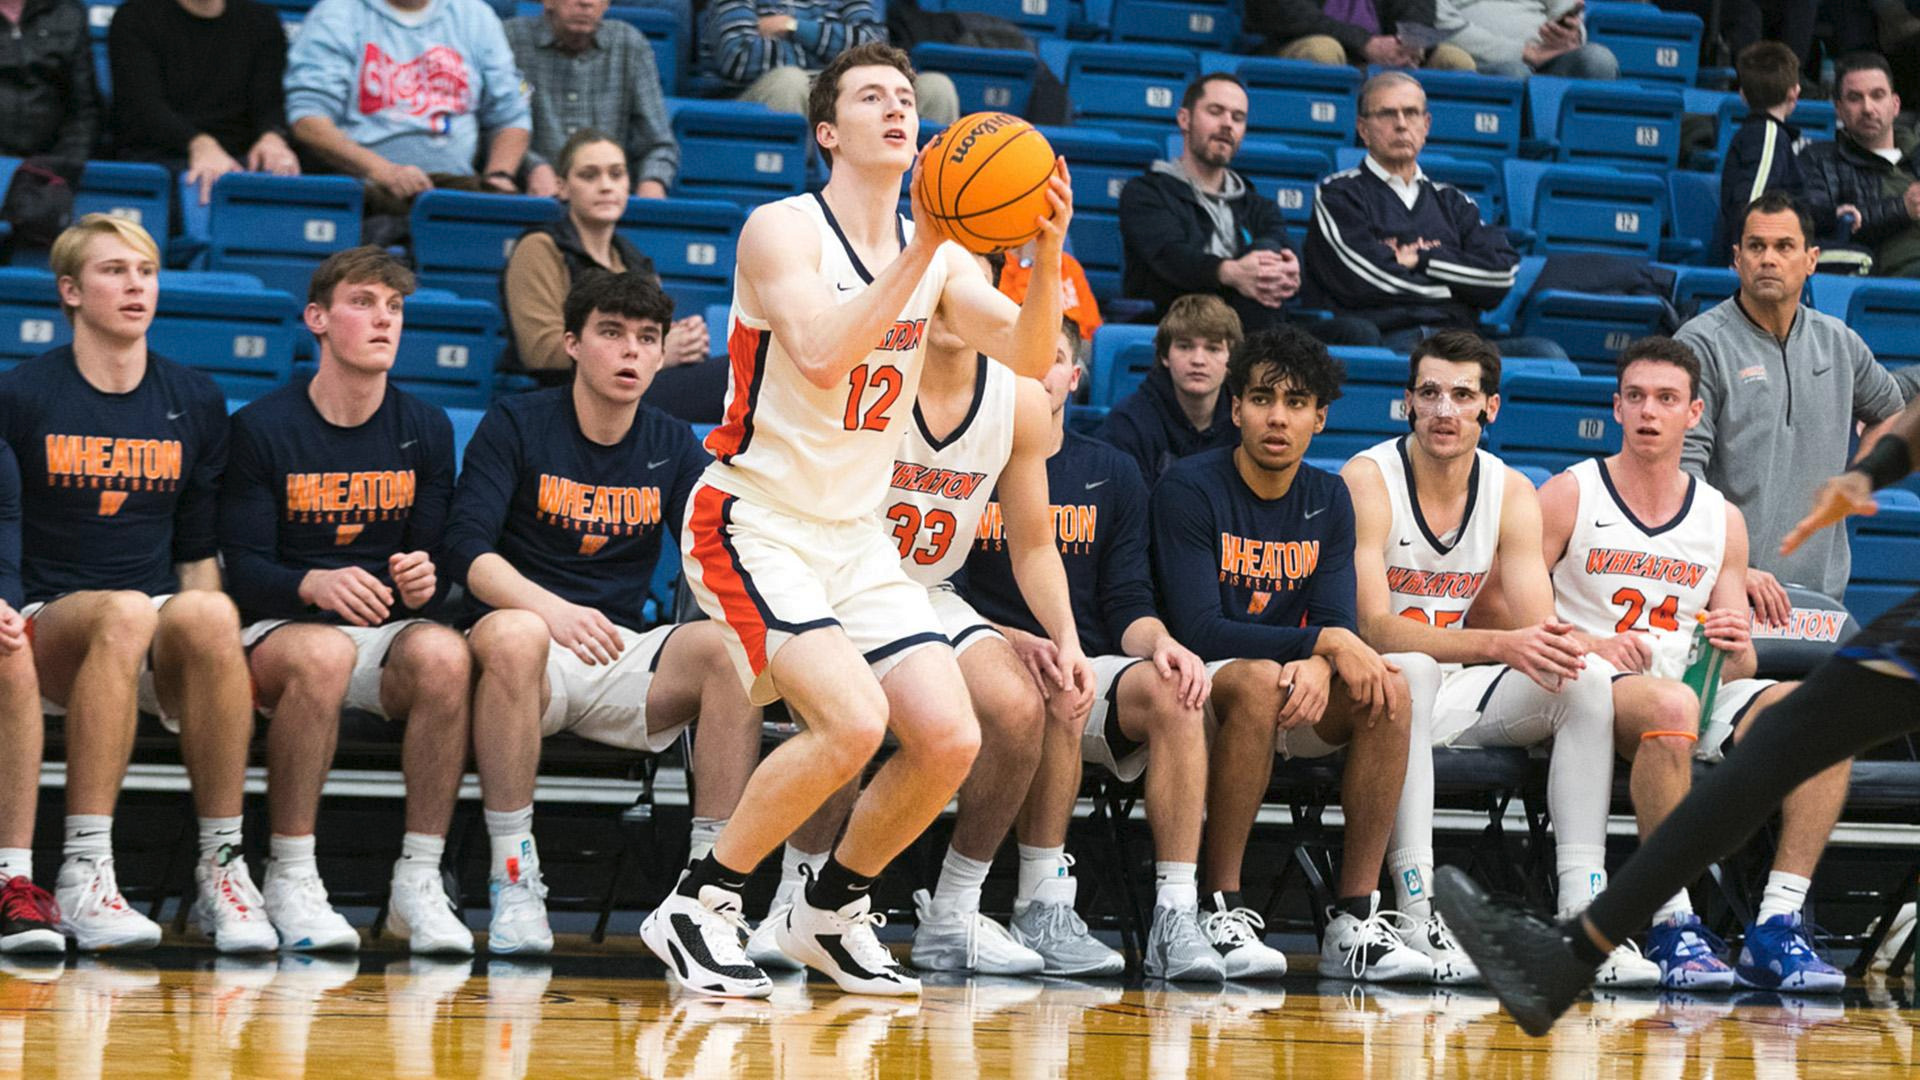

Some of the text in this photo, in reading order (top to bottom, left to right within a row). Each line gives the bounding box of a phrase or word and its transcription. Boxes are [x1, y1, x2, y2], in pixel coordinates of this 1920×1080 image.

[950, 114, 1018, 163] Wilson
[843, 364, 903, 431] 12
[46, 434, 182, 479] WHEATON
[286, 469, 416, 511] WHEATON
[538, 473, 661, 526] WHEATON
[886, 502, 957, 565] 33
[1586, 548, 1708, 589] WHEATON
[1612, 587, 1680, 634] 24
